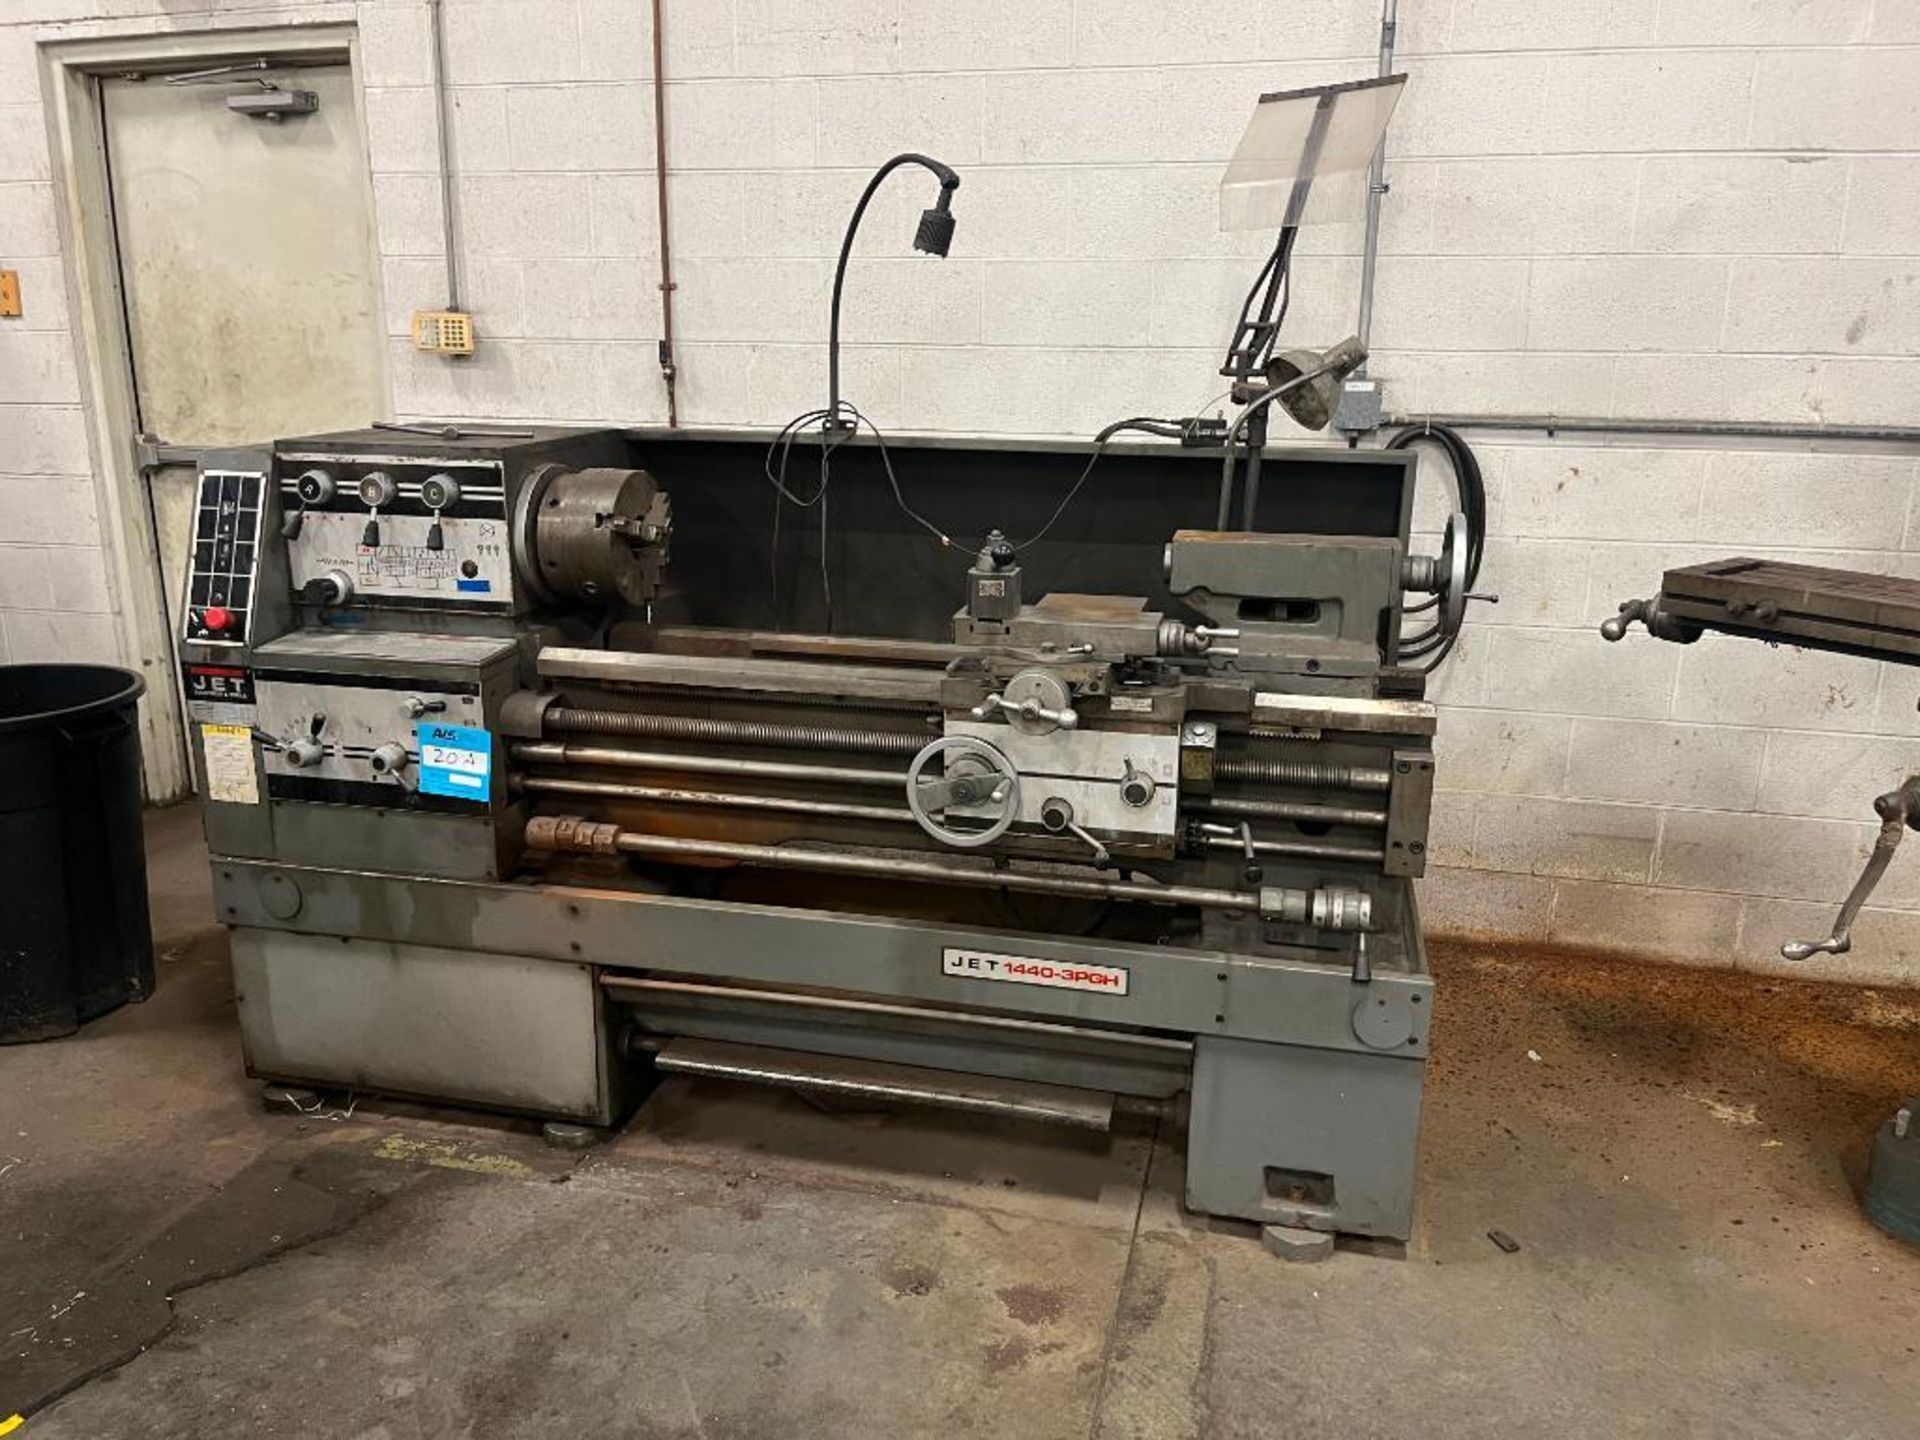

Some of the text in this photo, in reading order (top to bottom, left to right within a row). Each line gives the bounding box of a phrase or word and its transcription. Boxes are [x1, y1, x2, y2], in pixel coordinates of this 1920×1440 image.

[368, 486, 376, 498] B
[429, 488, 438, 499] C
[193, 675, 245, 692] JET
[433, 748, 458, 765] 20
[951, 956, 1119, 987] JET 1440-3PGH
